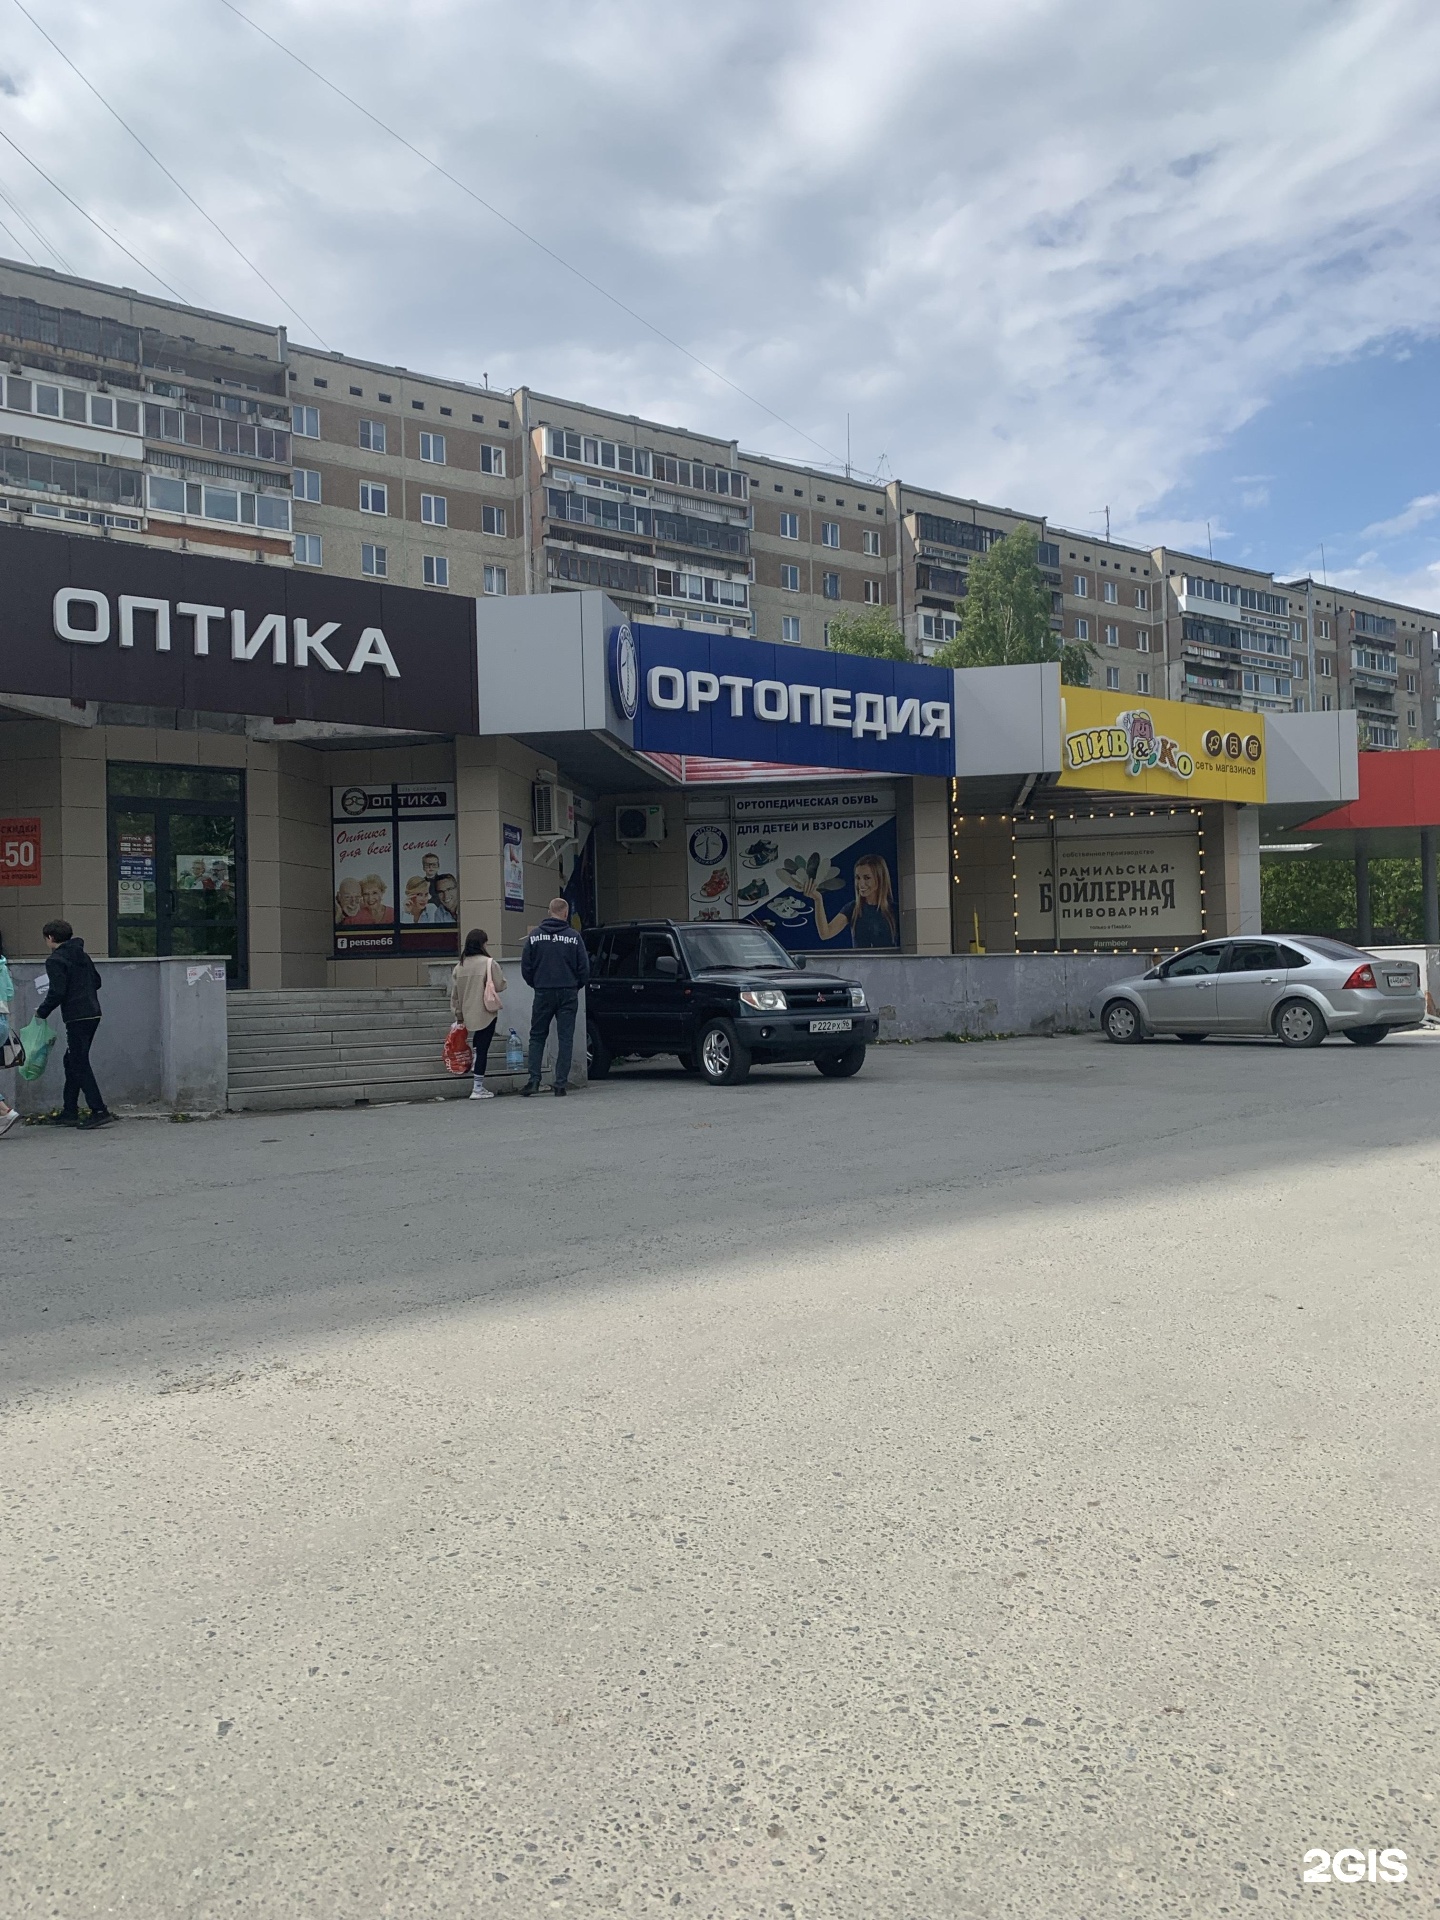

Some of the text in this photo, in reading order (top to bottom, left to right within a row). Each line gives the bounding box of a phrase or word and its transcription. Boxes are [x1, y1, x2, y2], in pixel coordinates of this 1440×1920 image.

[54, 587, 401, 678] ОПТИКА
[647, 666, 951, 741] ОРТОПЕДИЯ
[1195, 760, 1256, 775] сеть магазинов
[372, 794, 442, 807] ОПТИКА
[737, 795, 879, 810] ОРТОПЕДИЧЕСКАЯ ОБУВЬ
[1, 825, 37, 834] СКИДКИ
[694, 827, 722, 837] ОПОРА
[737, 820, 875, 836] ДЛЯ ДЕТЕЙ И ВЗРОСЛЫХ
[336, 828, 387, 845] Оптика
[339, 847, 361, 863] для
[367, 842, 393, 856] всей
[402, 839, 438, 851] семьи
[1039, 876, 1176, 913] БОЙЛЕРНАЯ
[1062, 906, 1159, 918] ПИВОВАРНЯ
[350, 937, 393, 948] pensne66
[530, 934, 550, 945] Palm
